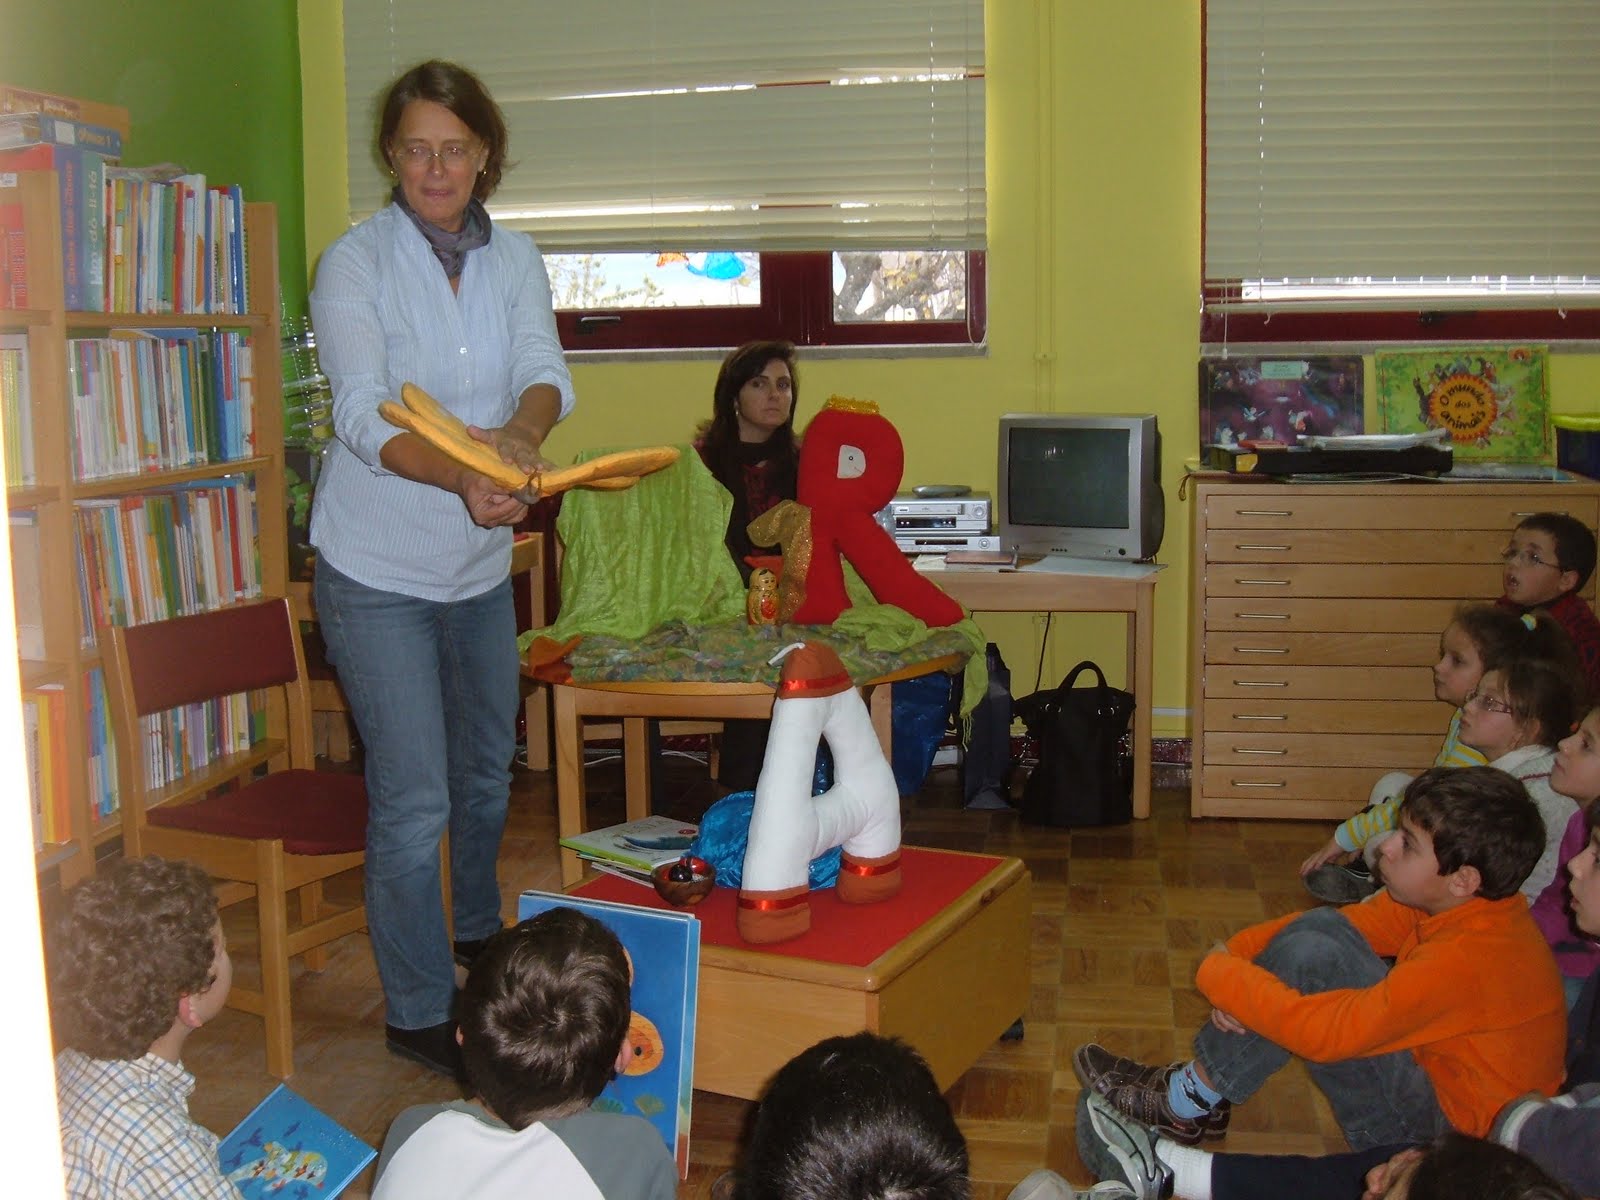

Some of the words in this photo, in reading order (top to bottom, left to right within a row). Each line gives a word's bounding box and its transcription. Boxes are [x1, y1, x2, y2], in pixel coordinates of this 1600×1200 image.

[1440, 395, 1450, 406] O
[1448, 384, 1485, 405] mundo
[1455, 400, 1471, 408] dos
[1440, 410, 1486, 430] animais
